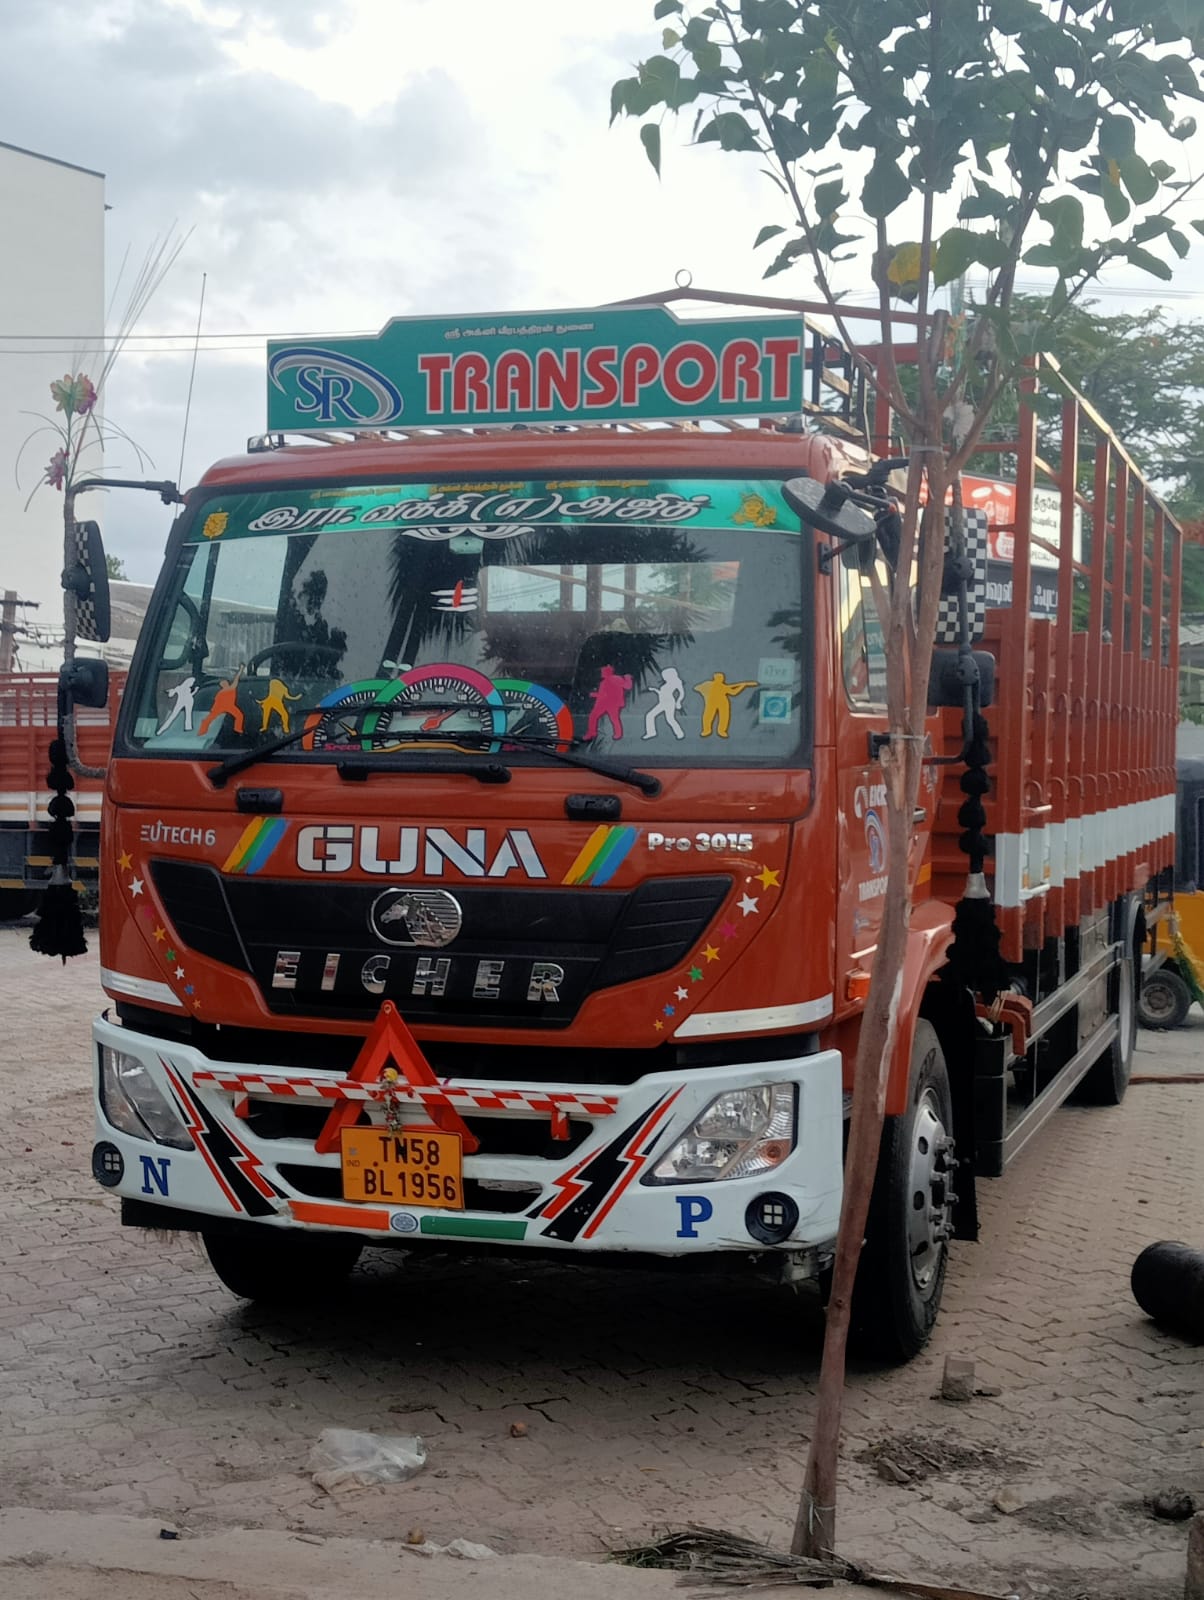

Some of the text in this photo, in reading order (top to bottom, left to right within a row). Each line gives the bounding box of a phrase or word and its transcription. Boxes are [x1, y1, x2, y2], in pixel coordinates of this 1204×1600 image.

[417, 335, 801, 414] TRANSPORT
[140, 819, 217, 846] EUTECH 6
[296, 824, 548, 880] GUNA
[648, 833, 753, 852] Pro 3015
[271, 950, 565, 1003] EICHER
[379, 1136, 440, 1166] TN58
[139, 1155, 171, 1197] N
[675, 1196, 713, 1238] P
